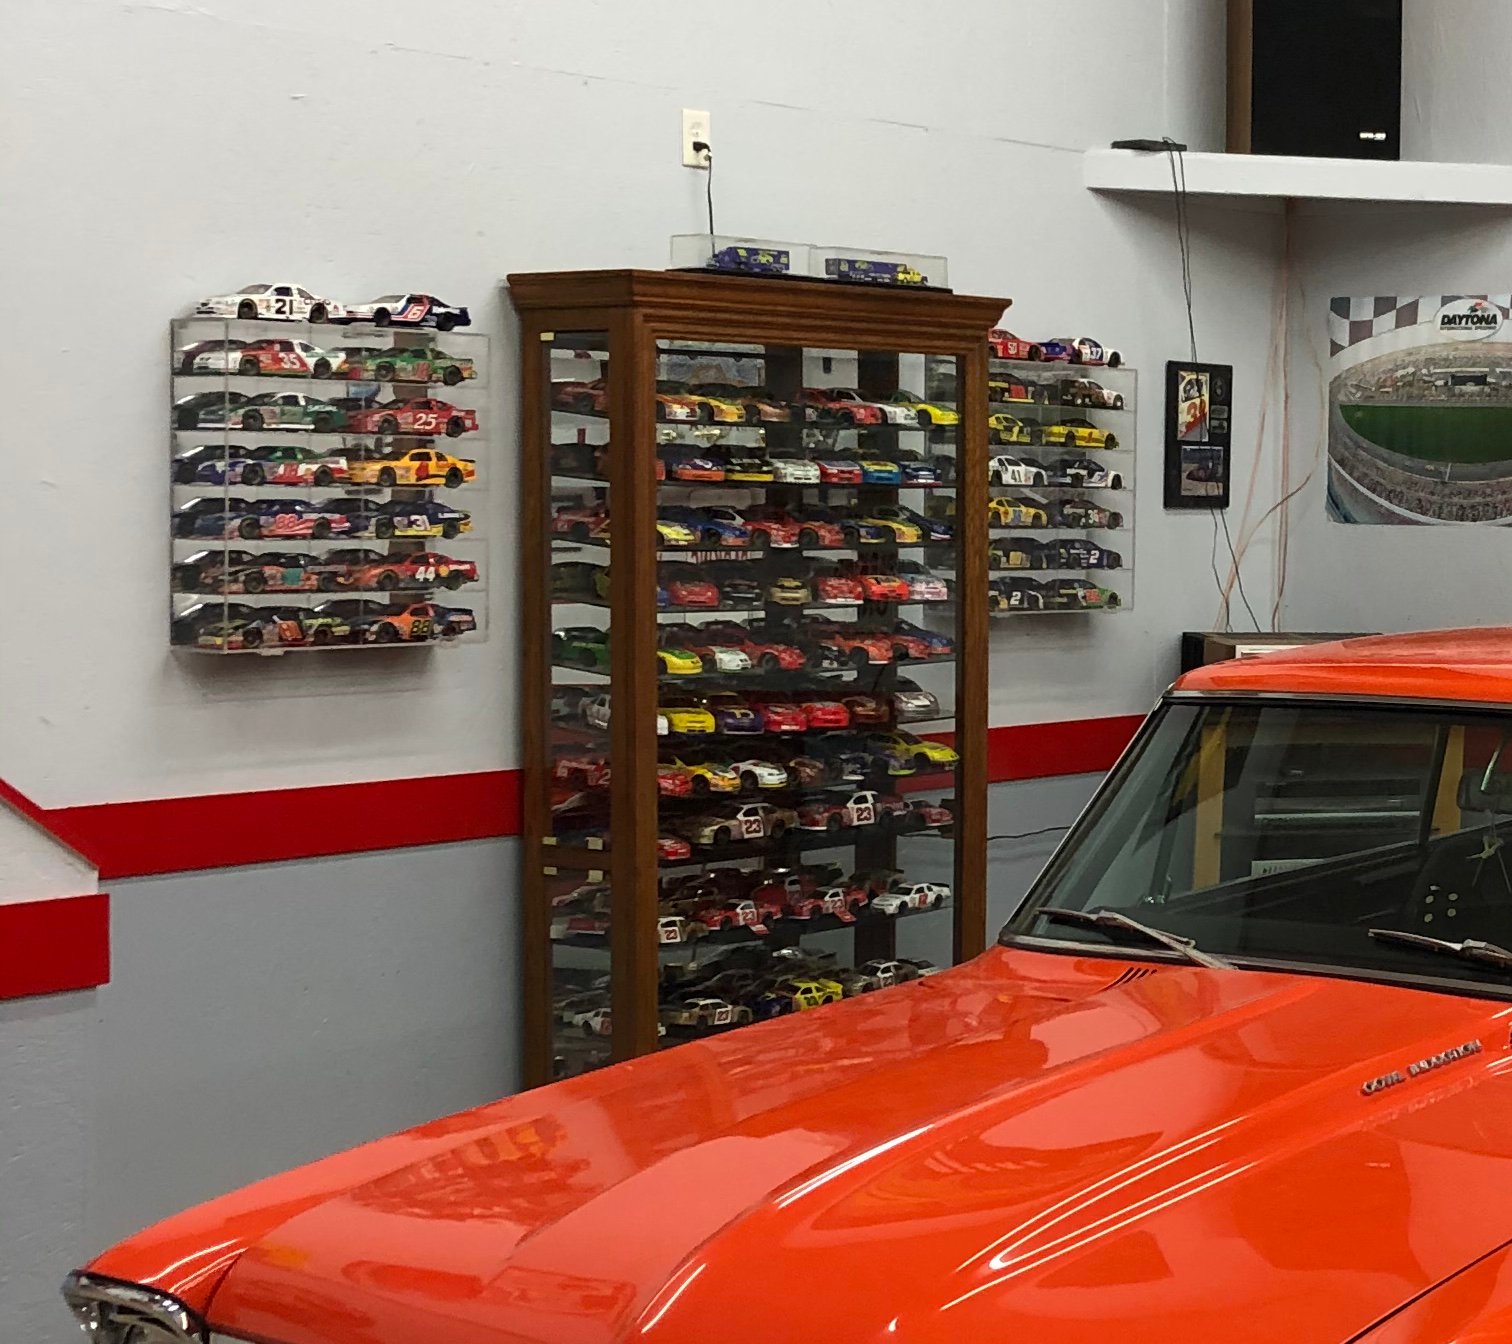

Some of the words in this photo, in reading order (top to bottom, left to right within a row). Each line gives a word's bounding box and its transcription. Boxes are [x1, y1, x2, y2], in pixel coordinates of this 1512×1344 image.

[274, 298, 294, 316] 21
[1440, 312, 1498, 327] DAYTONA
[279, 352, 301, 369] 35
[413, 413, 438, 430] 25
[275, 513, 299, 530] 88
[1088, 549, 1100, 564] 2
[414, 566, 437, 582] 44
[1009, 591, 1022, 605] 2
[855, 806, 873, 822] 23
[744, 819, 762, 835] 23
[741, 910, 755, 922] 23
[664, 928, 678, 941] 23
